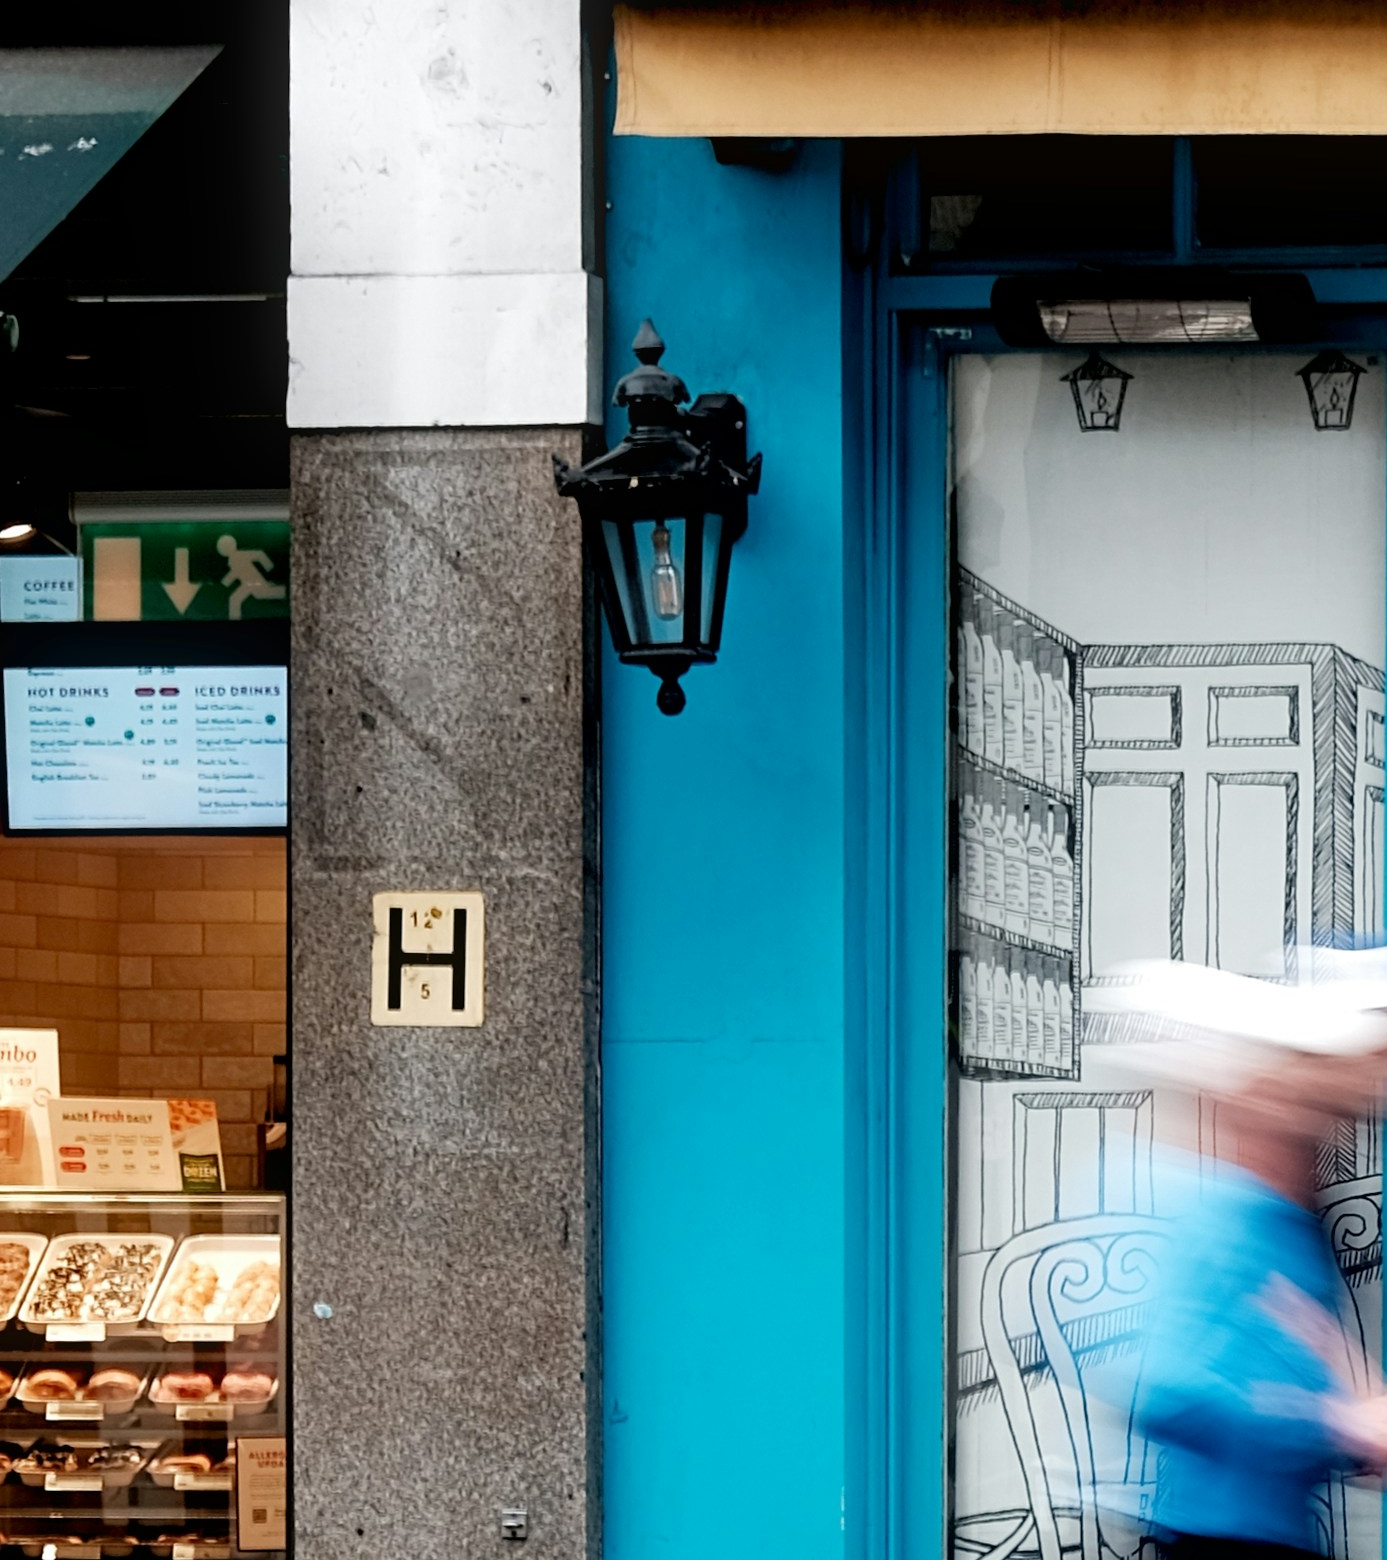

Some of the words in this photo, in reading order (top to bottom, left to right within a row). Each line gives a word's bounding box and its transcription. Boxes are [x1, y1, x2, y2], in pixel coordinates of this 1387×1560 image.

[23, 581, 75, 592] COFFEE
[28, 688, 54, 699] HOT
[59, 687, 110, 698] DRINKS
[195, 686, 226, 697] ICED
[230, 685, 281, 696] DRINKS
[387, 907, 468, 1011] H
[420, 984, 430, 999] 5
[62, 1112, 90, 1123] MADE
[92, 1110, 125, 1124] Fresh
